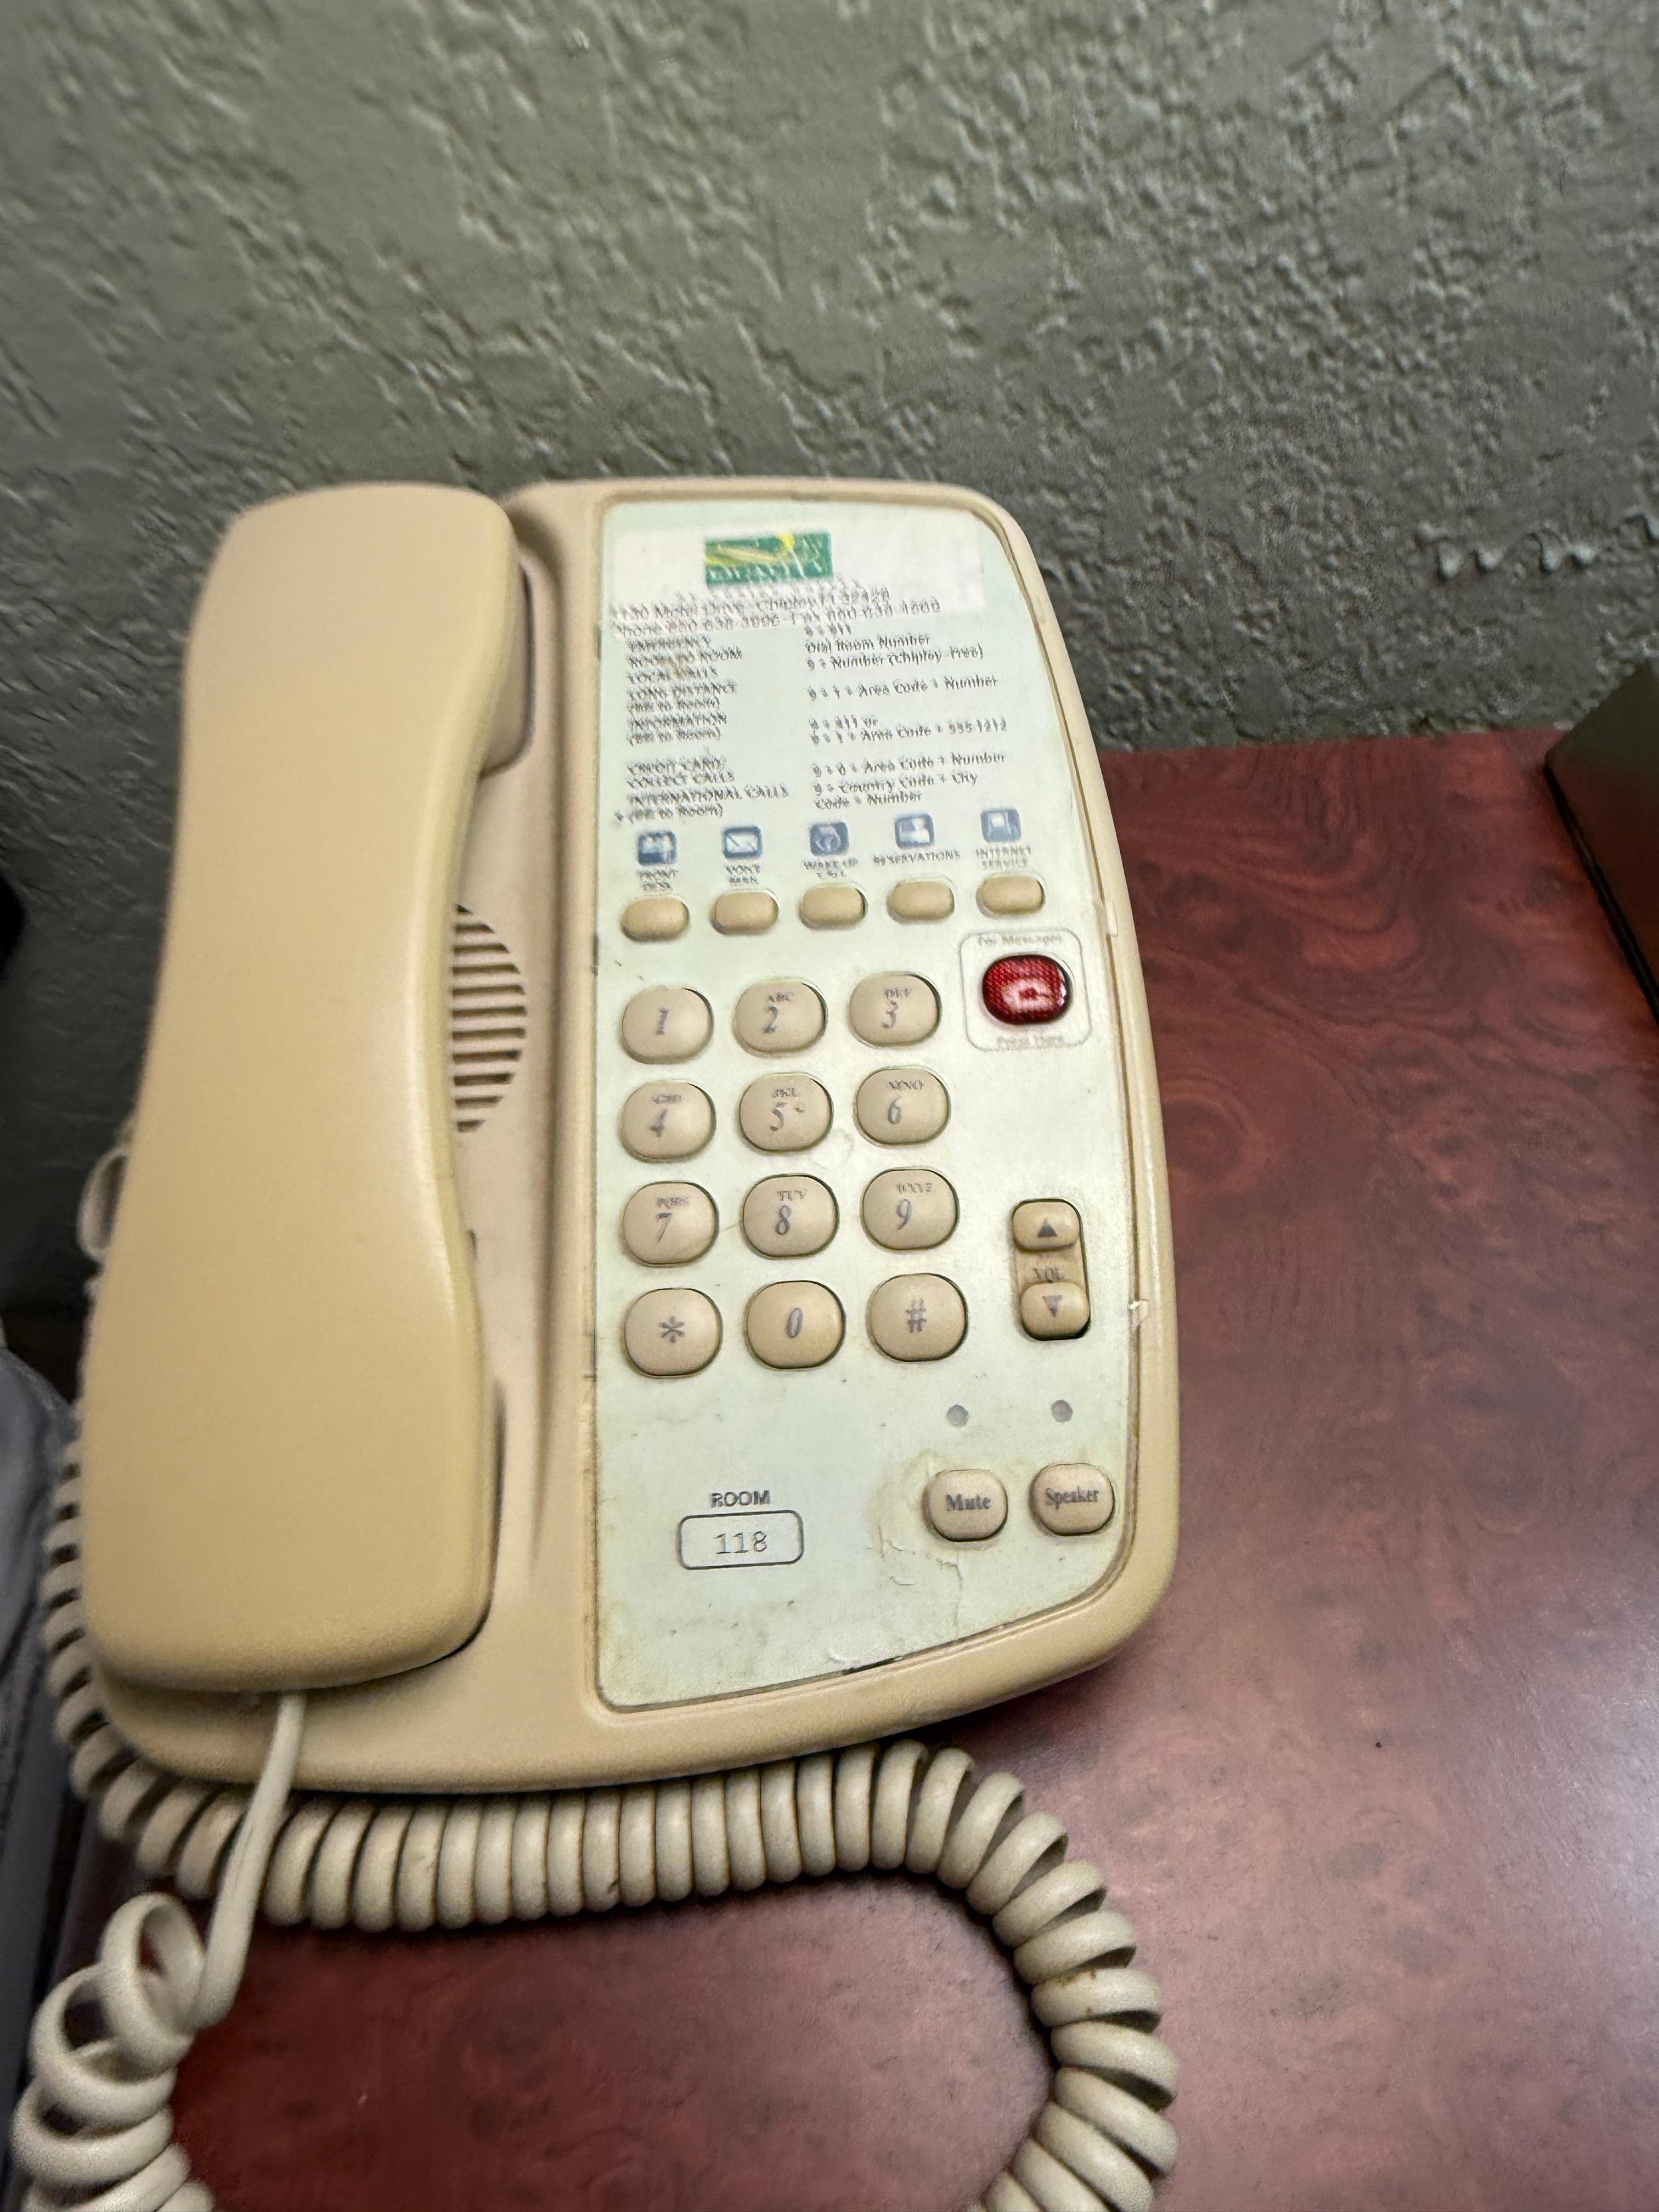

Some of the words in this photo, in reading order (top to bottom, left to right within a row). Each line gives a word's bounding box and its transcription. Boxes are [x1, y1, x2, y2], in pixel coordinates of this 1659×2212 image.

[655, 1006, 670, 1036] 1
[763, 1005, 778, 1035] 2
[881, 1000, 900, 1030] 3
[649, 1108, 668, 1141] 4
[769, 1101, 788, 1132] 5
[887, 1095, 902, 1126] 6
[656, 1211, 674, 1244] 7
[775, 1205, 791, 1236] 8
[895, 1198, 913, 1231] 9
[786, 1307, 804, 1339] 0
[905, 1299, 927, 1334] #
[710, 1489, 771, 1508] ROOM
[946, 1493, 992, 1511] Mute
[1045, 1486, 1099, 1511] Speaker
[714, 1530, 768, 1554] 118
